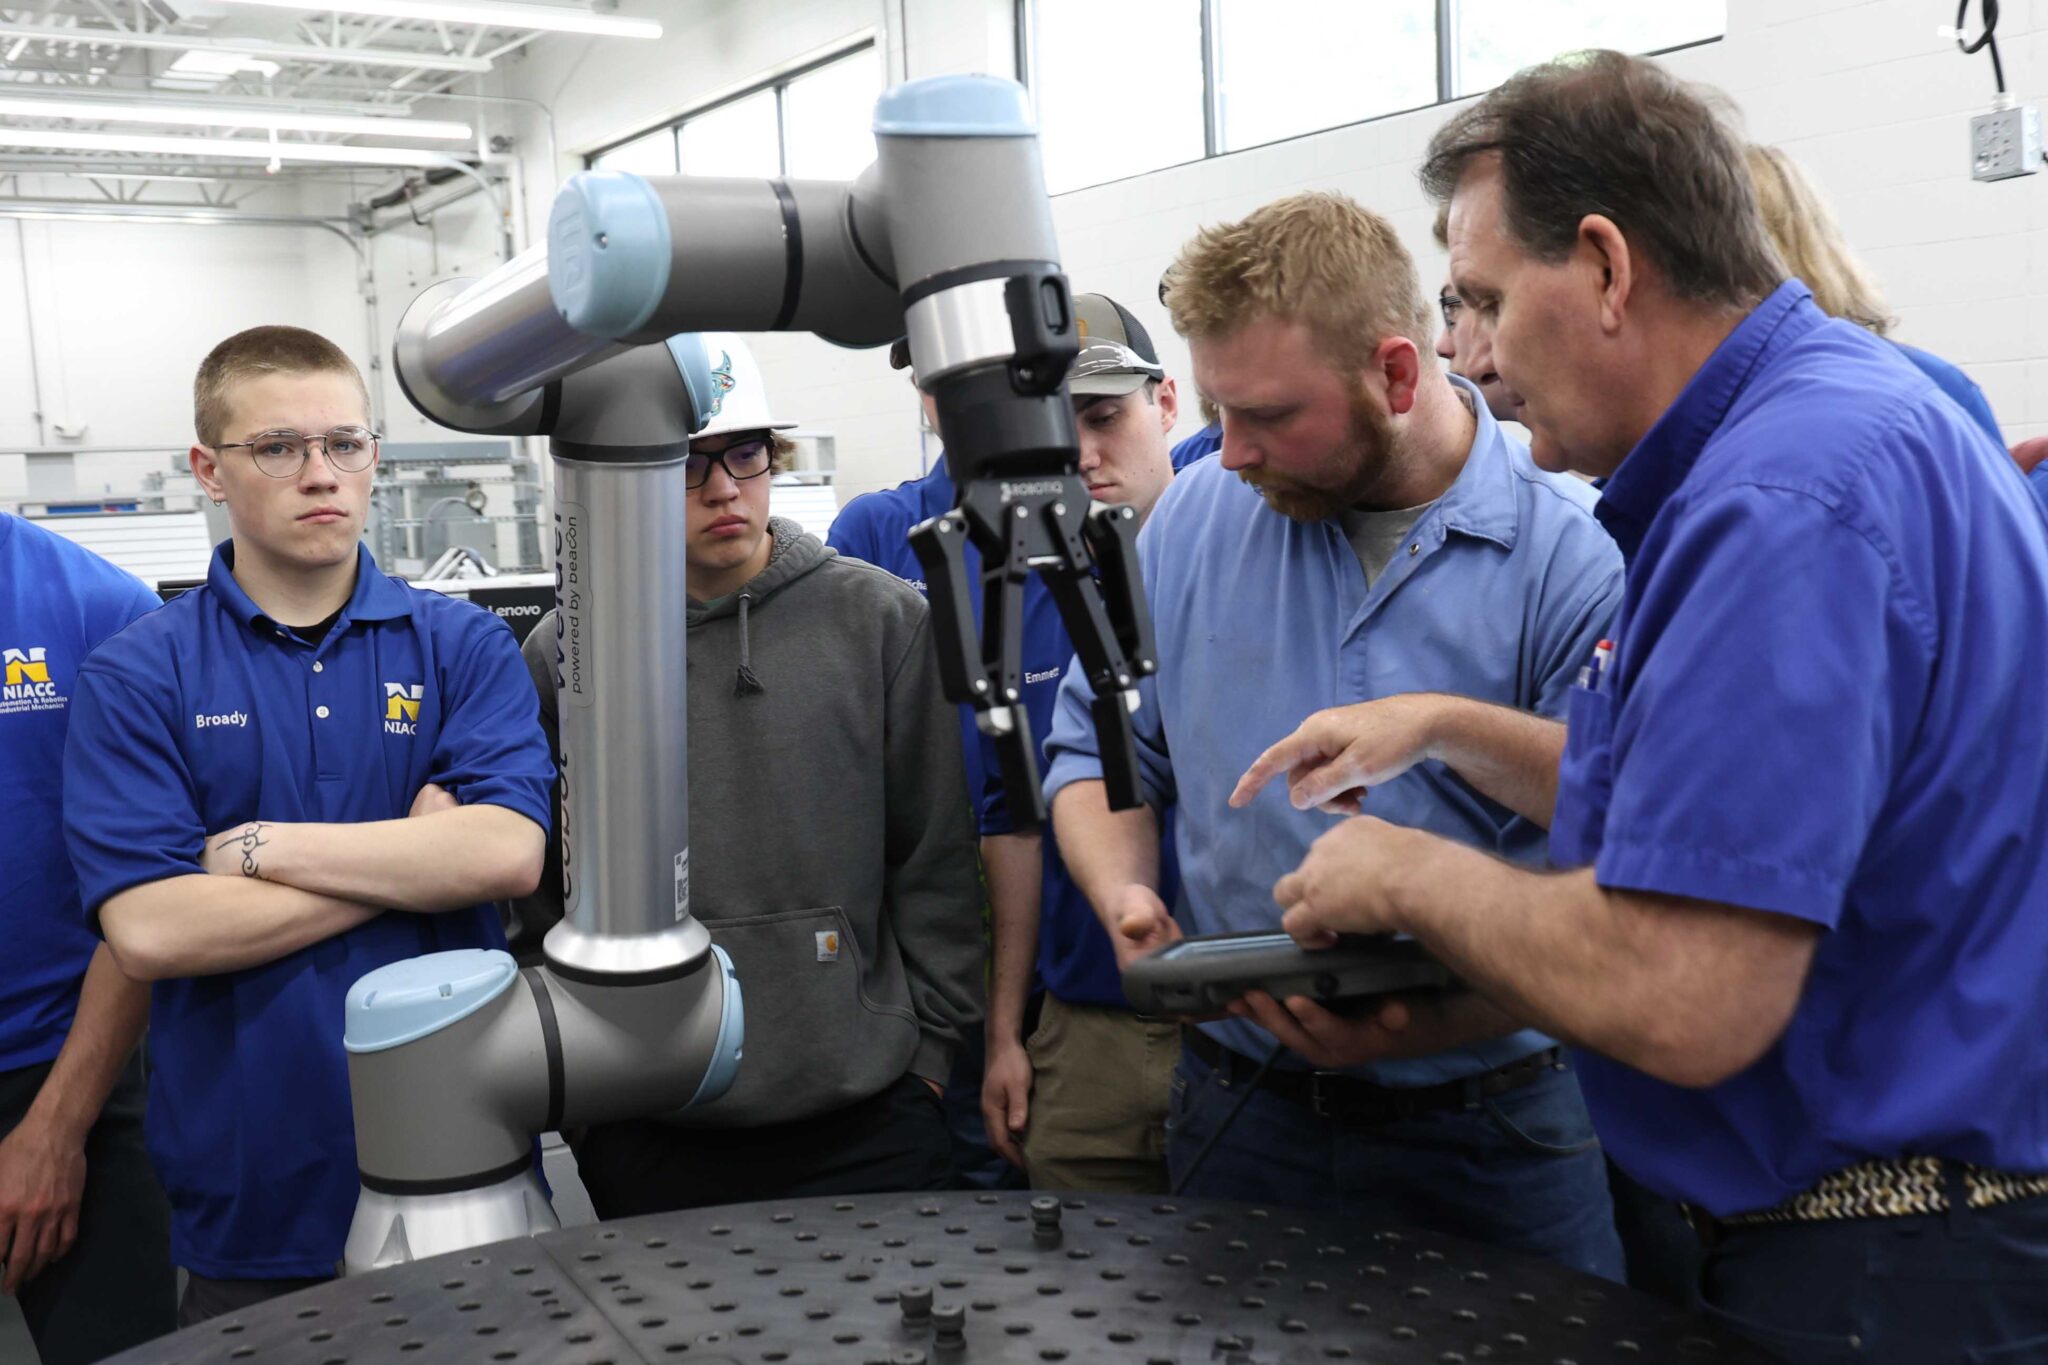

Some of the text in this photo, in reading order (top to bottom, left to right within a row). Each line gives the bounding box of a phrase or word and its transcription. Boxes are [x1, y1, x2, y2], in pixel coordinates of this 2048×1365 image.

[487, 605, 541, 617] Lenovo
[566, 516, 582, 694] powered by beacon
[3, 682, 56, 700] NIACC
[31, 703, 65, 711] Mechanics
[40, 695, 68, 704] Robotics
[196, 710, 248, 729] Broady
